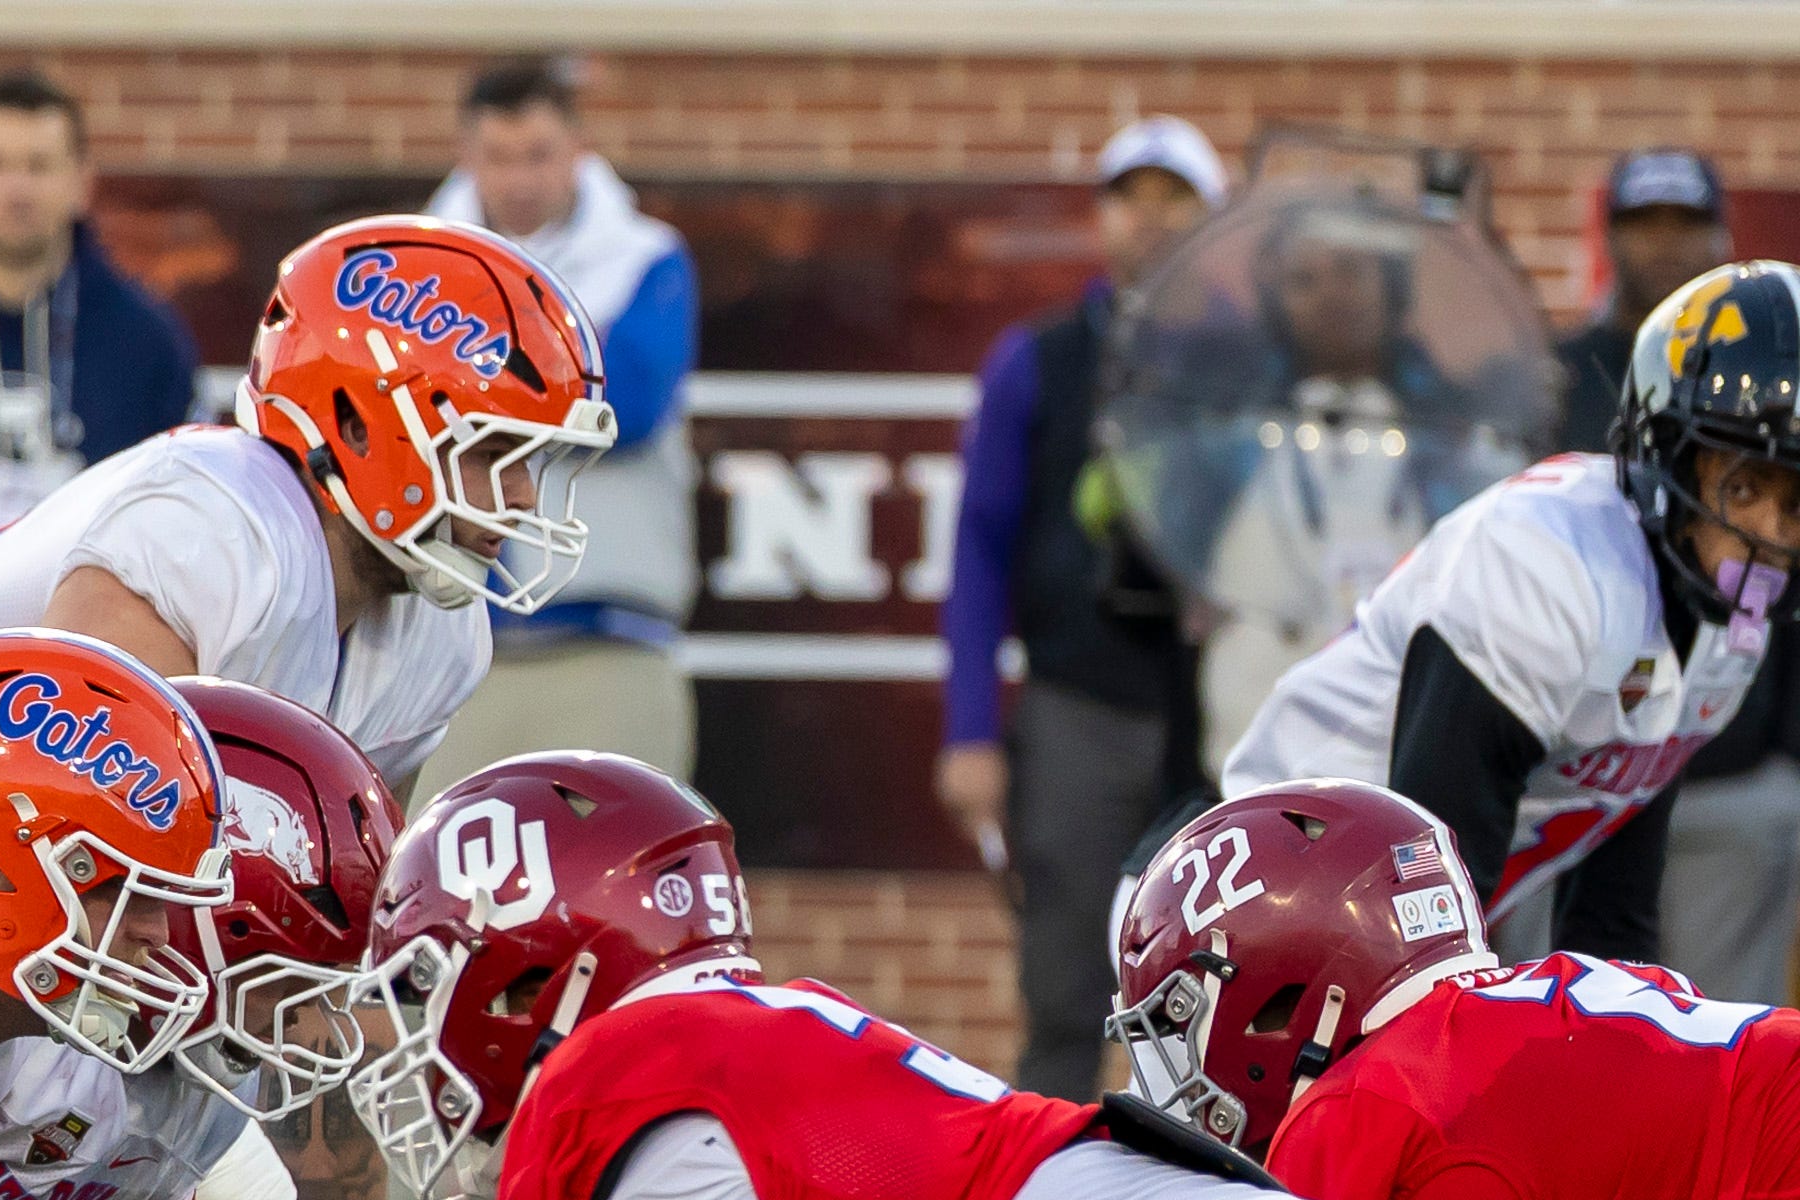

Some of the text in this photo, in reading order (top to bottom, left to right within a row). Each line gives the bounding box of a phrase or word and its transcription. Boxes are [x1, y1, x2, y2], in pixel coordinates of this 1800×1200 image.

[333, 249, 512, 379] Gators
[437, 797, 556, 932] OU
[1171, 826, 1266, 936] 22
